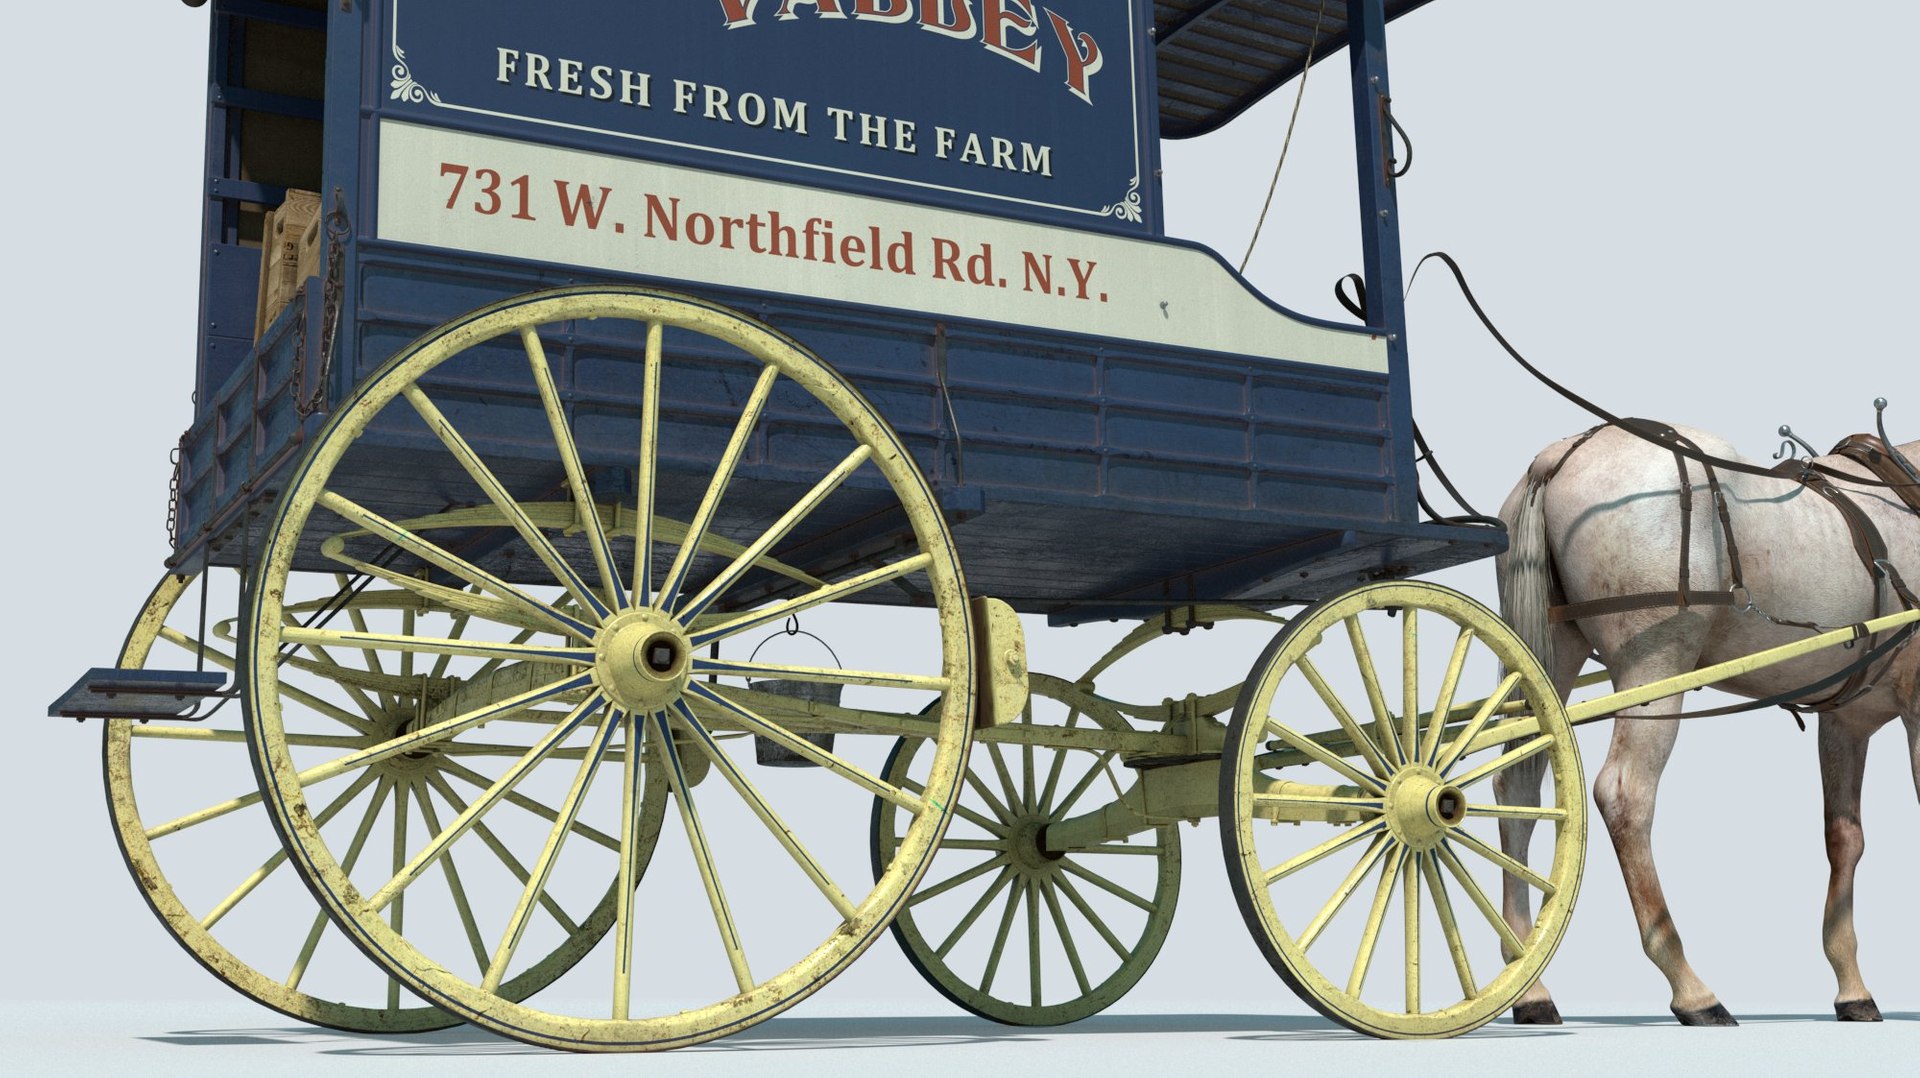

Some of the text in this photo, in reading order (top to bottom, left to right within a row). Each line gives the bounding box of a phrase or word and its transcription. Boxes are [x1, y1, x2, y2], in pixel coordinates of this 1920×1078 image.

[496, 47, 1053, 178] FRESH FROM THE FARM
[440, 162, 1109, 302] 731 W. Northfield Rd. N.Y.
